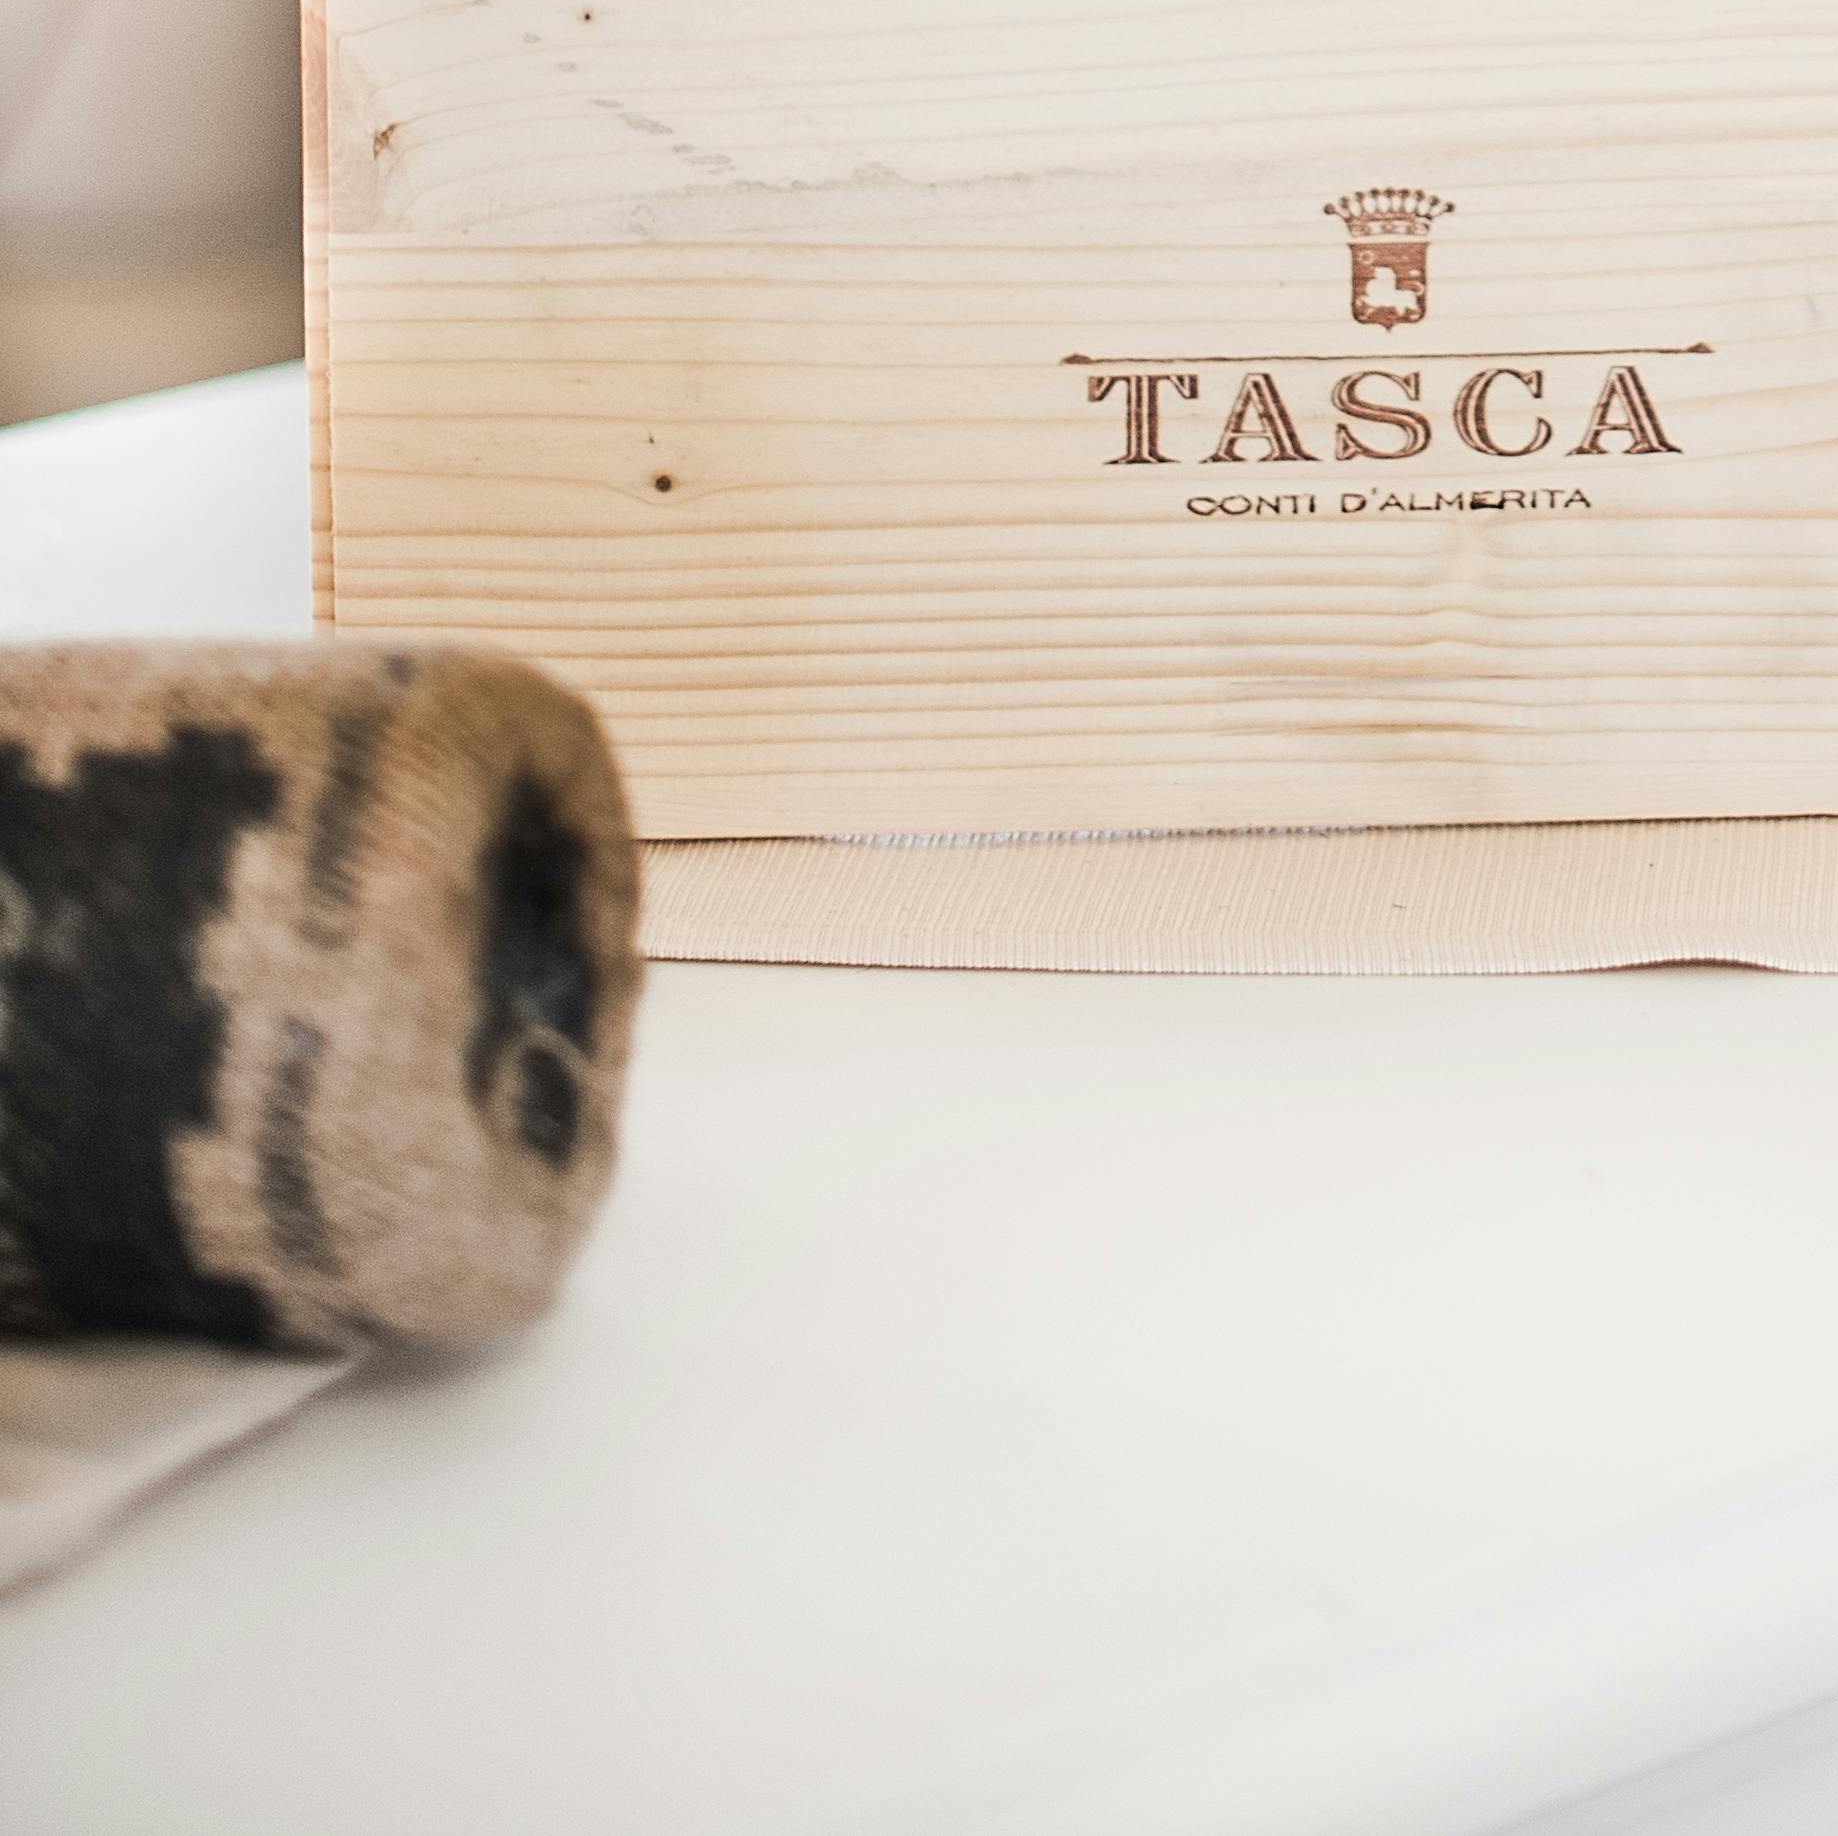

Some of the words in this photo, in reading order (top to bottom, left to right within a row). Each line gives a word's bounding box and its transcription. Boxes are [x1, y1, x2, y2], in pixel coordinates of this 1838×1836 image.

[1086, 364, 1684, 466] TASCA
[1186, 492, 1318, 516] CONTI
[1339, 486, 1593, 514] D'ALMERITA
